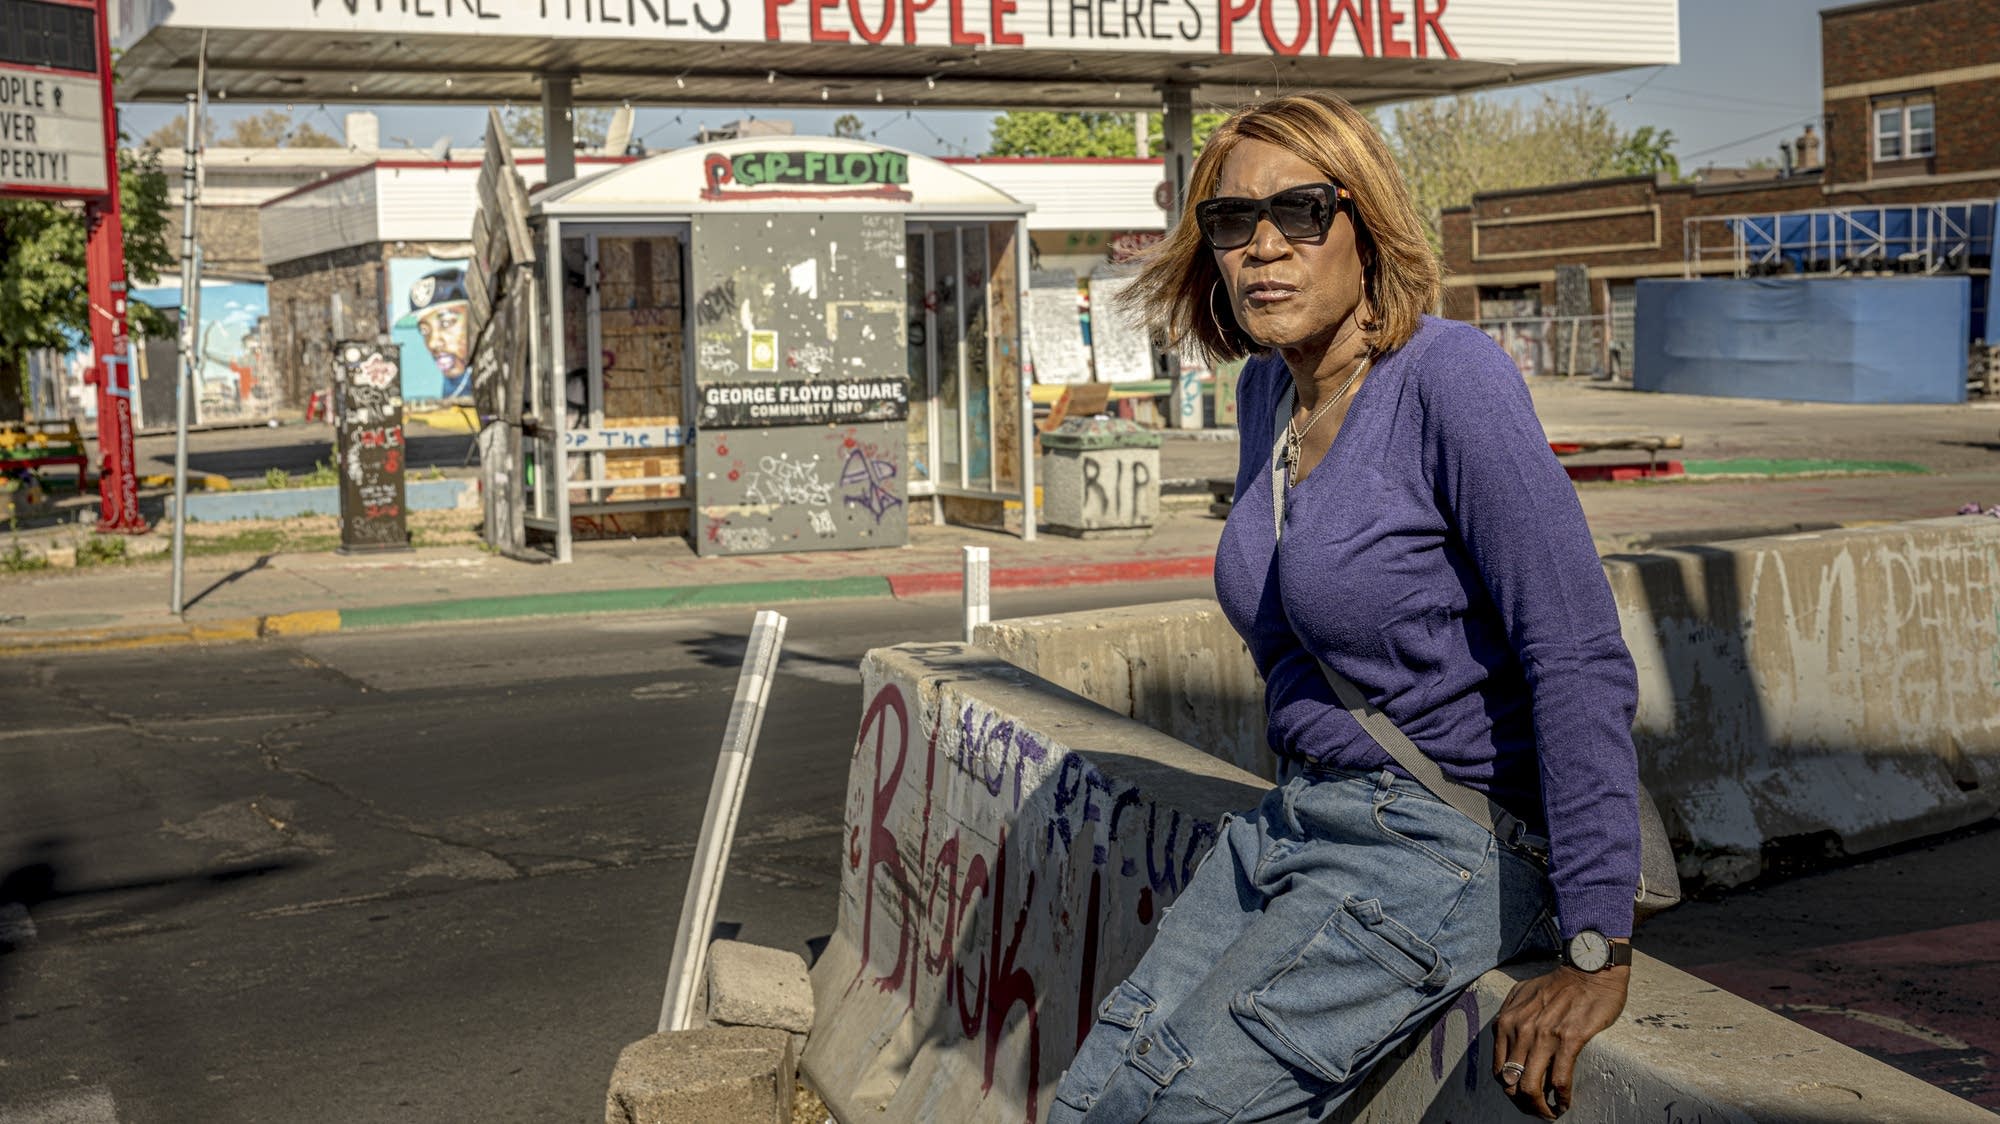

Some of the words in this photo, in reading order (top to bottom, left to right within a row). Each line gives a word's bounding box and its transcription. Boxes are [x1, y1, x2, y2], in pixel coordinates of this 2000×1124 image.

[1219, 0, 1461, 60] POWER
[0, 149, 68, 181] PERTY!
[706, 387, 776, 405] GEORGE
[779, 385, 833, 403] FLOYD
[837, 383, 903, 401] SQUARE
[750, 404, 829, 418] COMMUNITY
[598, 430, 652, 448] The
[1083, 456, 1150, 525] RIP
[957, 702, 1050, 812] NOT
